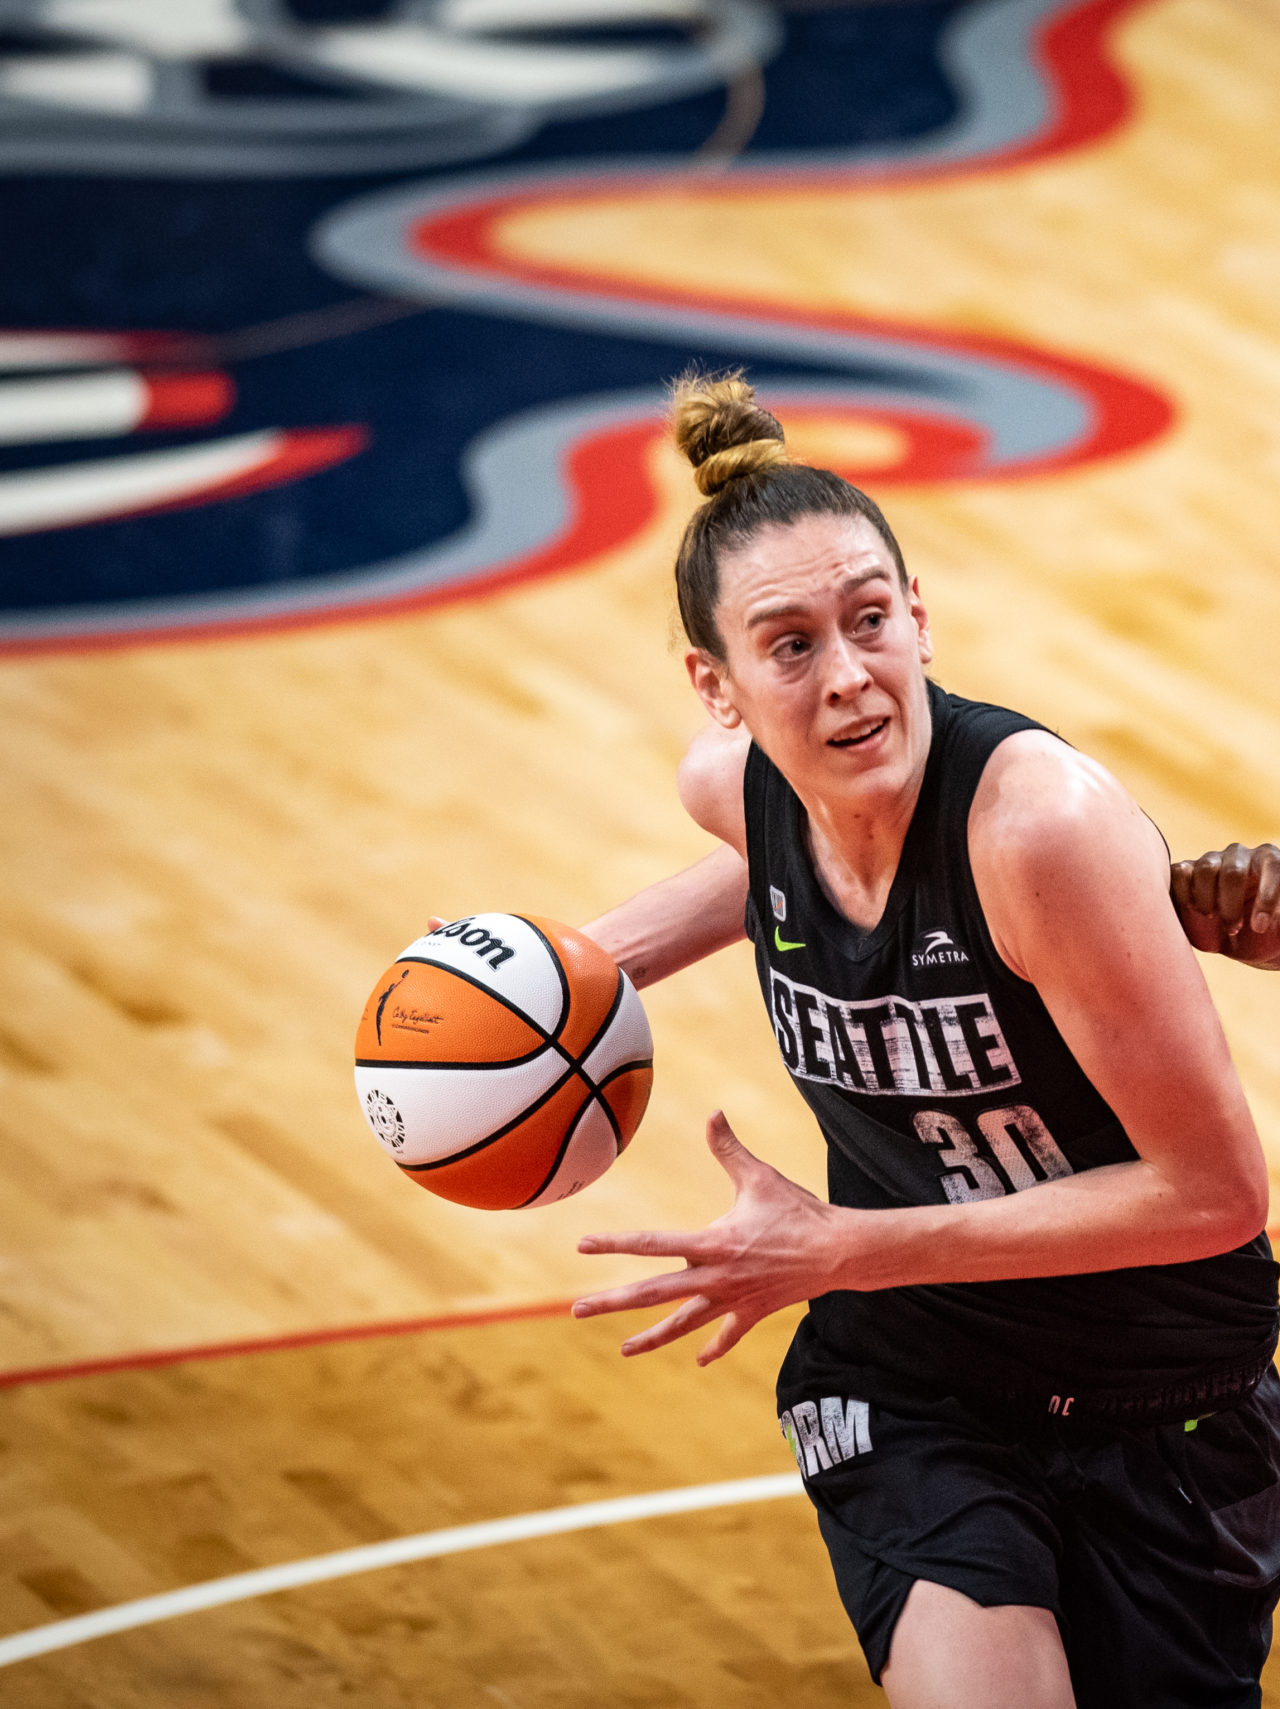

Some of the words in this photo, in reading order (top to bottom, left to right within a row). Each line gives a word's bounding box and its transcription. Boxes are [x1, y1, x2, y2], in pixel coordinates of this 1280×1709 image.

[425, 917, 515, 970] lson
[912, 951, 969, 966] SYMETRA
[770, 968, 1021, 1096] SEATTLE
[913, 1104, 1074, 1204] 30
[779, 1396, 873, 1482] ORM
